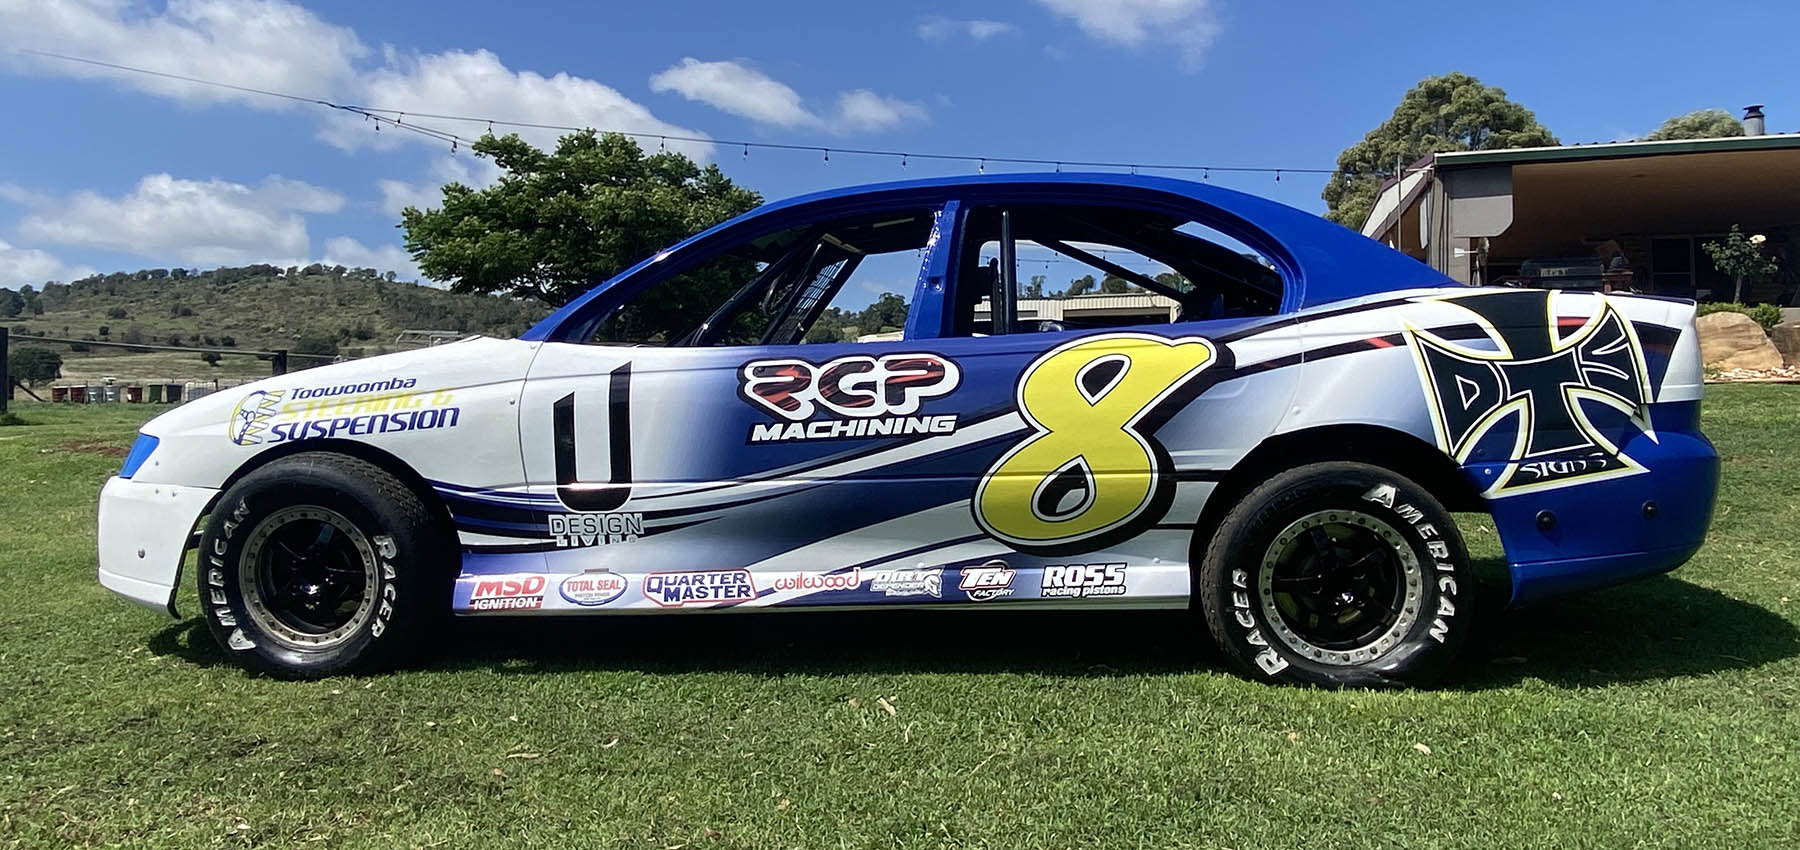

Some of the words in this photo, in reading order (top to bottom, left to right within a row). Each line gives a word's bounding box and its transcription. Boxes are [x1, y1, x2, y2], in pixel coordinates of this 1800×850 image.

[291, 377, 416, 400] Toowoomba
[743, 355, 960, 421] RCP
[268, 407, 460, 443] SUSPENSION
[553, 361, 632, 512] U
[751, 415, 956, 442] MACHINING
[976, 333, 1216, 545] 8
[549, 513, 644, 536] DESIGN
[557, 534, 639, 547] LIVING
[207, 496, 257, 650] AMERICAN
[1361, 483, 1458, 643] AMERICAN
[371, 535, 398, 638] RACER
[475, 576, 545, 597] MSD
[567, 580, 595, 592] TOTAL
[597, 579, 621, 591] SEAL
[646, 572, 747, 593] QUARTER
[775, 568, 860, 590] wilwood
[961, 567, 1014, 588] TEN
[1042, 564, 1127, 588] ROSS
[663, 585, 751, 602] MASTER
[973, 588, 1015, 597] FACTORY
[1042, 586, 1081, 597] racing
[1082, 585, 1126, 597] pistons
[473, 597, 538, 610] IGNITION
[1231, 568, 1290, 675] RACER
